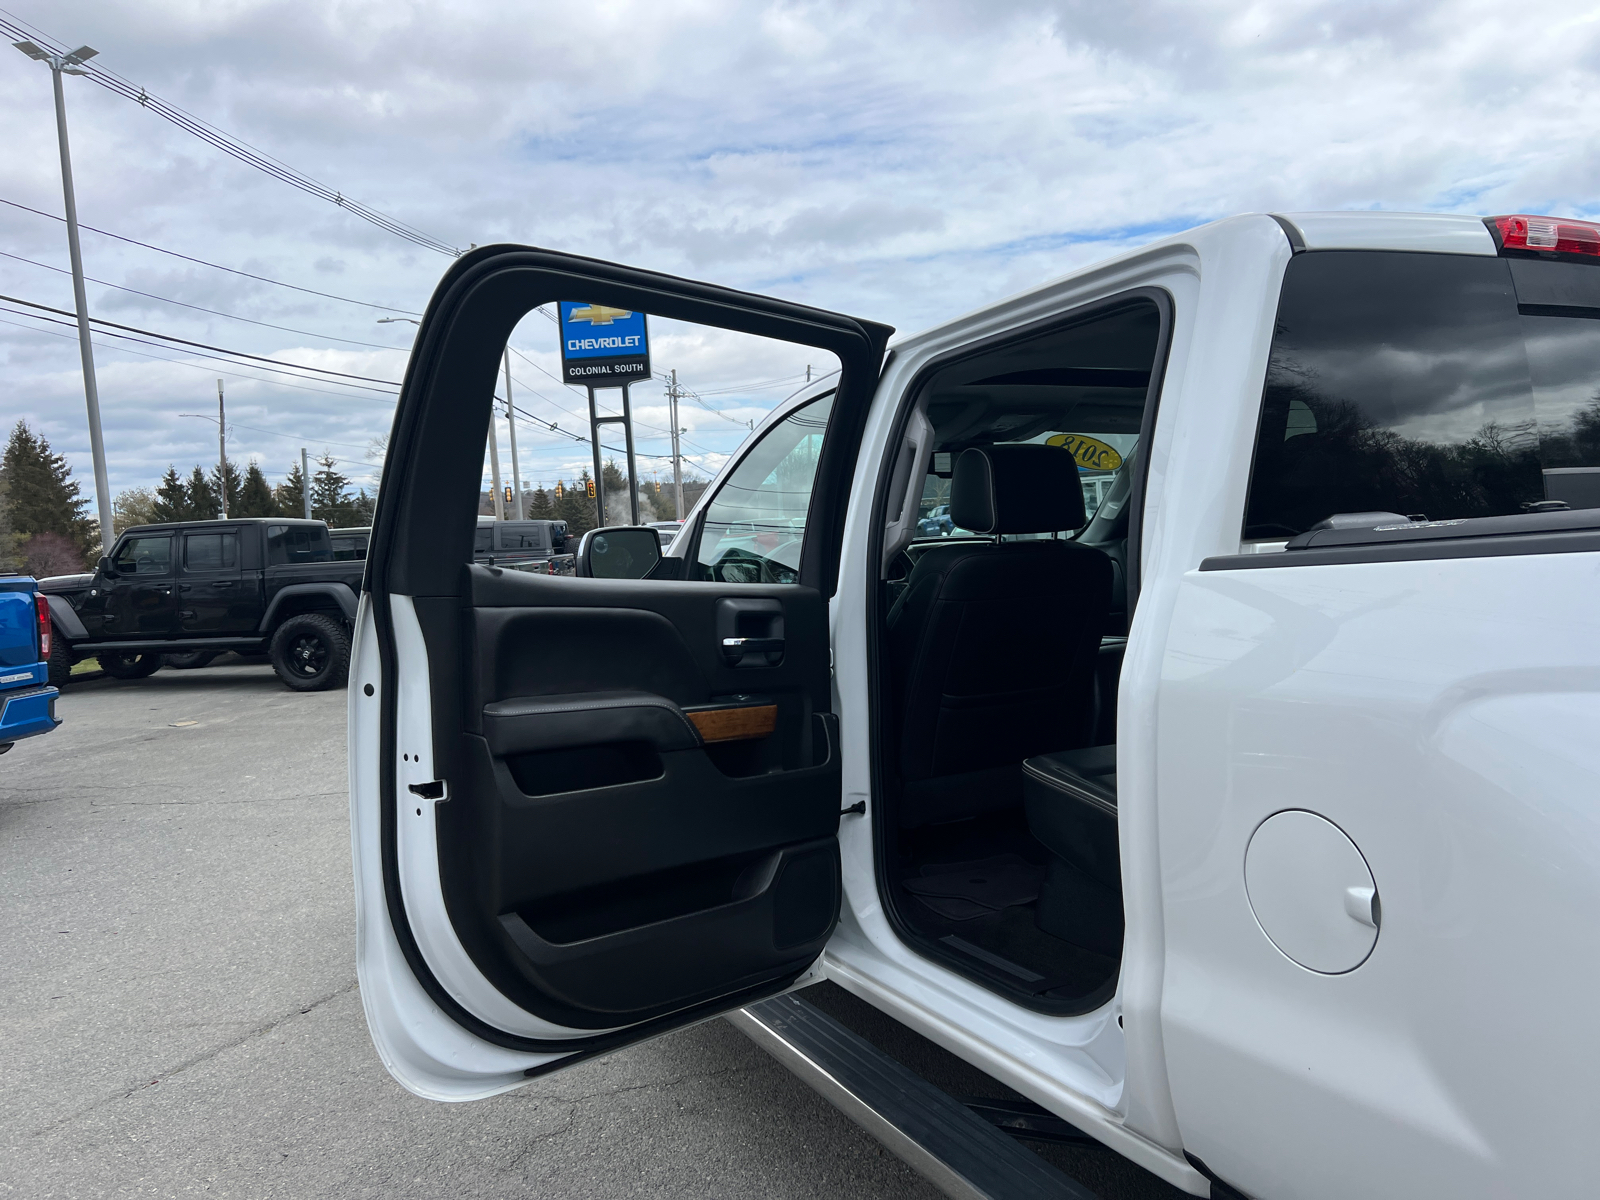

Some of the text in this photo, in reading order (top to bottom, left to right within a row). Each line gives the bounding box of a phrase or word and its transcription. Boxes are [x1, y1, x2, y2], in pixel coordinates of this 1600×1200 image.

[568, 336, 641, 351] CHEVROLET
[569, 363, 644, 376] COLONIAL SOUTH
